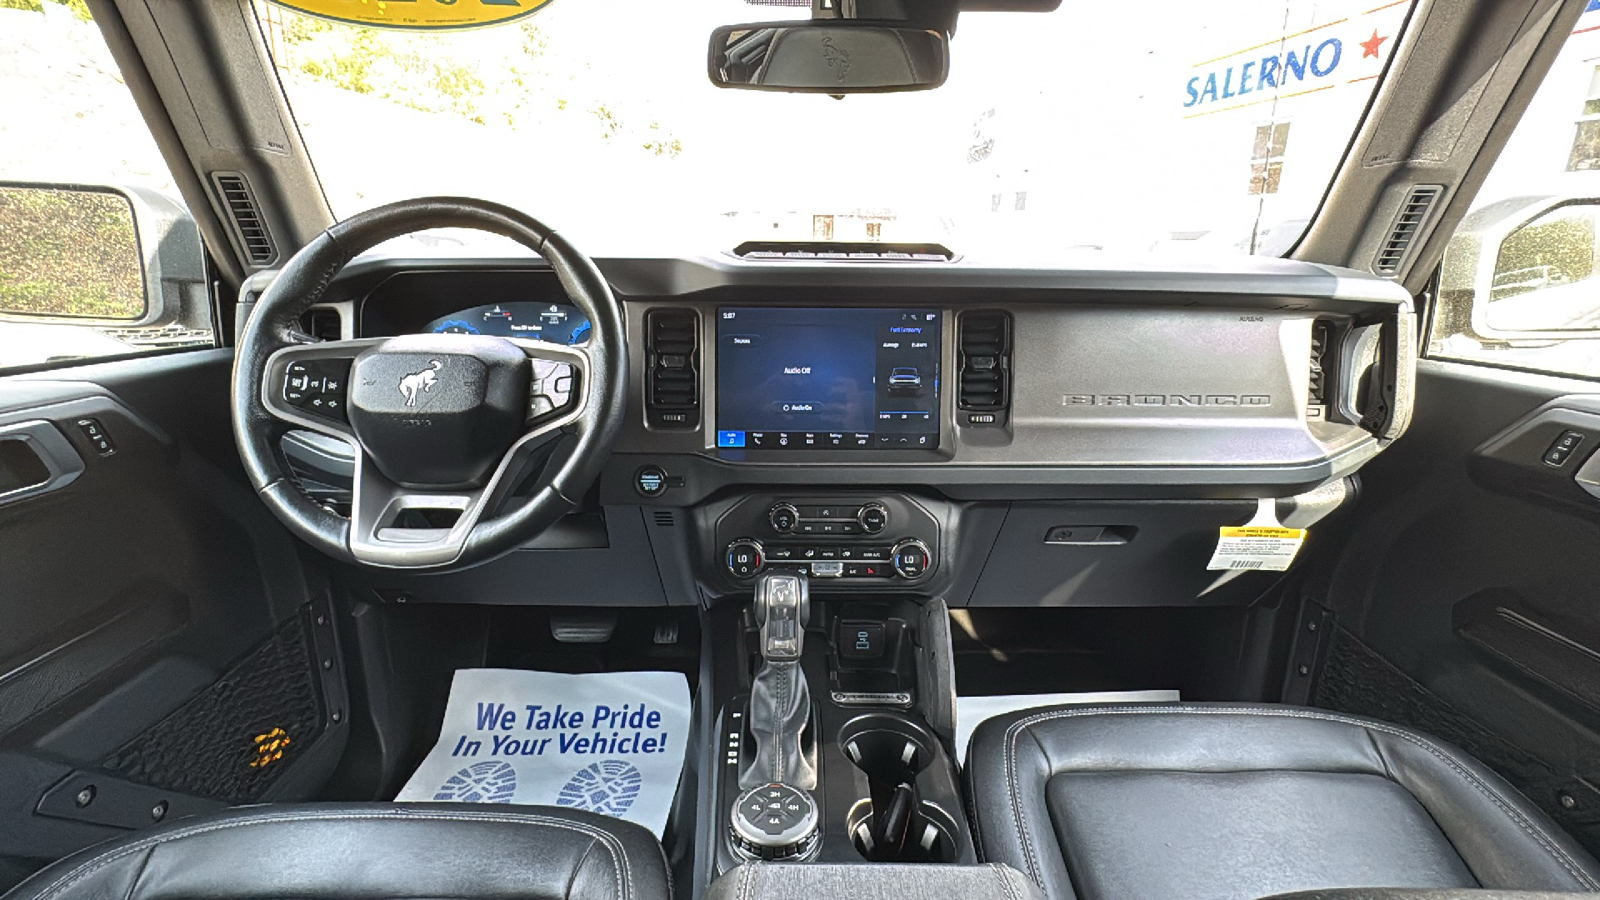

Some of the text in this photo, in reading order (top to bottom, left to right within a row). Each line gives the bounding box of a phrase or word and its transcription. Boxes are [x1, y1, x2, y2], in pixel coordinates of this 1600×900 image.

[1183, 37, 1343, 107] SALERNO
[1062, 394, 1271, 407] BRONCO
[738, 555, 747, 563] LO
[904, 555, 914, 564] LO
[476, 702, 661, 731] We Take Pride
[452, 732, 668, 757] In Your Vehicle!
